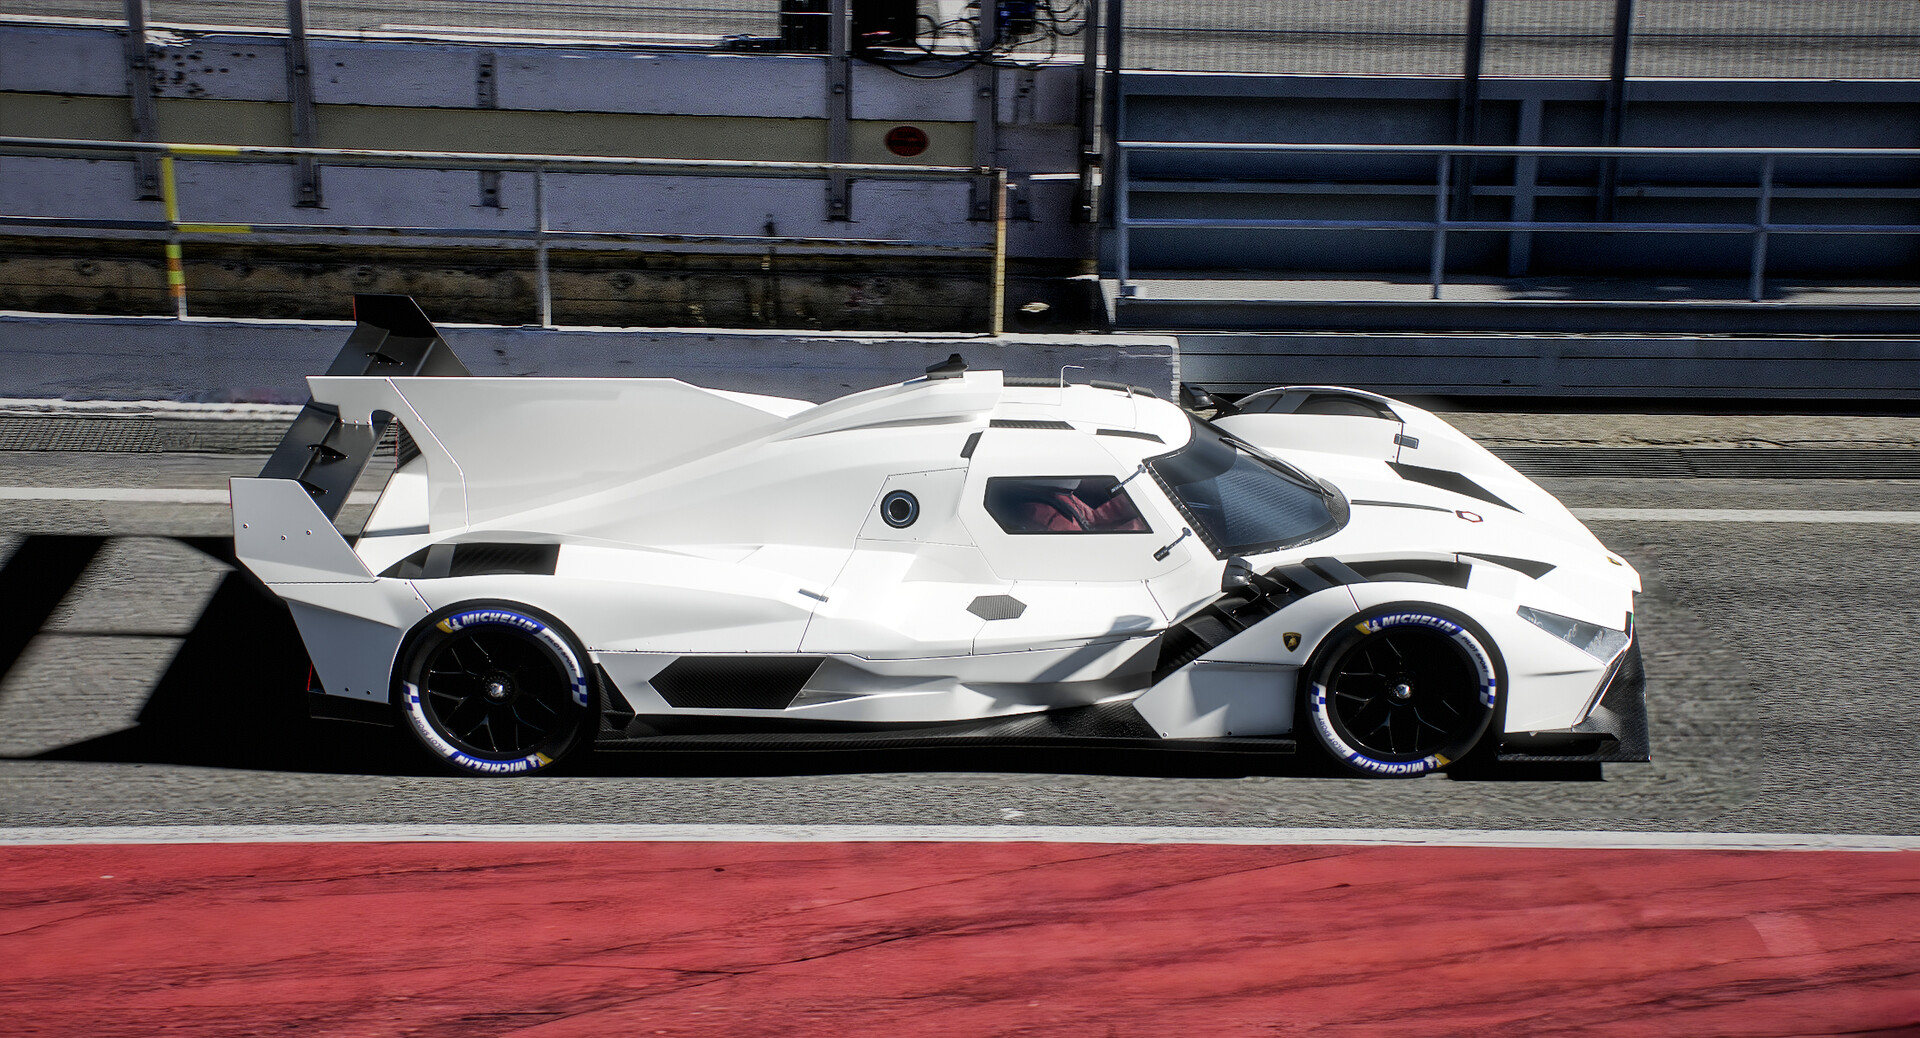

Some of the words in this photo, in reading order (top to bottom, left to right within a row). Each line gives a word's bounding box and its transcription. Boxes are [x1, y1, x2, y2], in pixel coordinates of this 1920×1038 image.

[462, 612, 538, 631] MICHELIN
[1382, 614, 1457, 632] MICHELIN
[1461, 636, 1479, 652] PILOT
[414, 716, 430, 736] SPORT
[1319, 717, 1332, 737] SPORT
[428, 737, 447, 753] PILOT
[1330, 738, 1347, 754] PILOT
[454, 755, 527, 773] MICHELIN
[1352, 756, 1424, 774] MICHELIN
